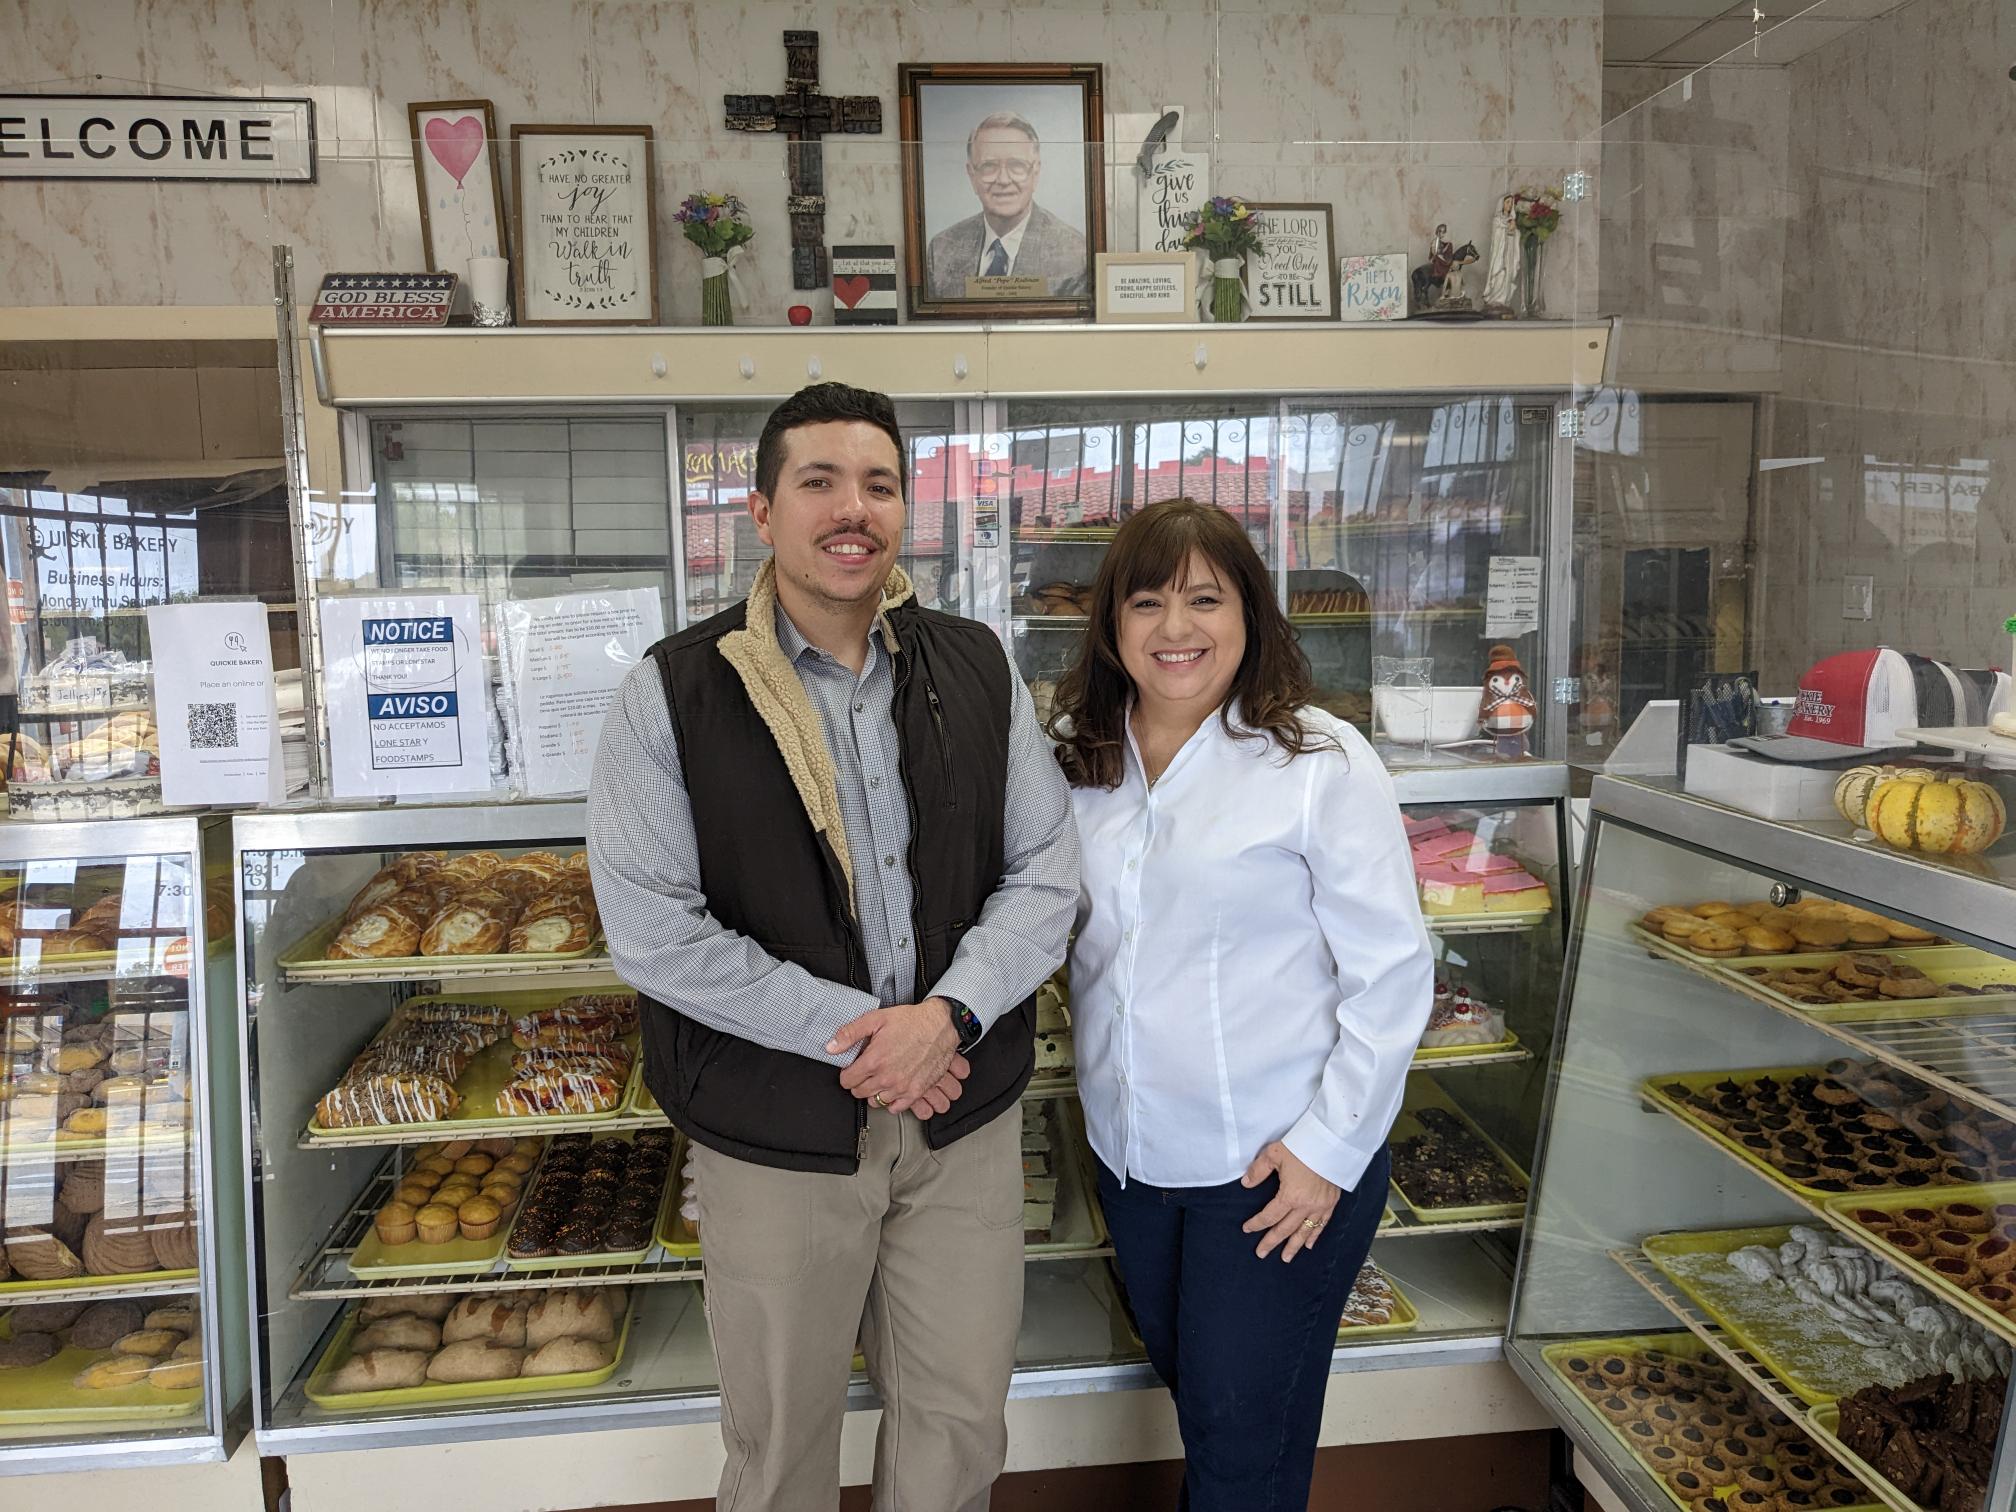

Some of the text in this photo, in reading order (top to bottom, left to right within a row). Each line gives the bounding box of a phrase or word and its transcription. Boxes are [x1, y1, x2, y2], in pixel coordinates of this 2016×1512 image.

[0, 117, 274, 161] ELCOME
[549, 175, 570, 183] HAVE
[574, 175, 587, 183] NO
[591, 174, 631, 184] GREATER
[1152, 173, 1195, 205] give
[557, 184, 618, 215] joy
[1175, 192, 1189, 203] us
[540, 214, 633, 224] THAN TO HEAR THAT
[556, 227, 619, 237] MY CHILDREN
[1283, 218, 1318, 238] LORD
[548, 240, 603, 260] Walk
[1276, 245, 1297, 254] YOU
[1258, 252, 1319, 274] Need Only
[561, 259, 618, 290] truth
[1365, 270, 1394, 283] HE IS
[324, 291, 445, 304] GOD BLESS
[1259, 282, 1322, 306] STILL
[1347, 281, 1402, 308] Risen
[318, 306, 439, 318] AMERICA
[47, 569, 164, 588] Business Hours:
[41, 593, 88, 611] Monday
[92, 595, 118, 608] thru
[370, 621, 445, 641] NOTICE
[210, 659, 238, 667] QUICKIE
[200, 681, 220, 689] Place
[232, 680, 255, 688] online
[57, 689, 90, 700] Jellies
[378, 695, 449, 716] AVISO
[373, 721, 446, 731] NO ACCEPTAMOS
[1815, 716, 1831, 724] 1969
[374, 739, 398, 747] LONE
[399, 739, 421, 747] STAR
[375, 754, 435, 763] FOODSTAMPS
[159, 885, 192, 897] 7:30
